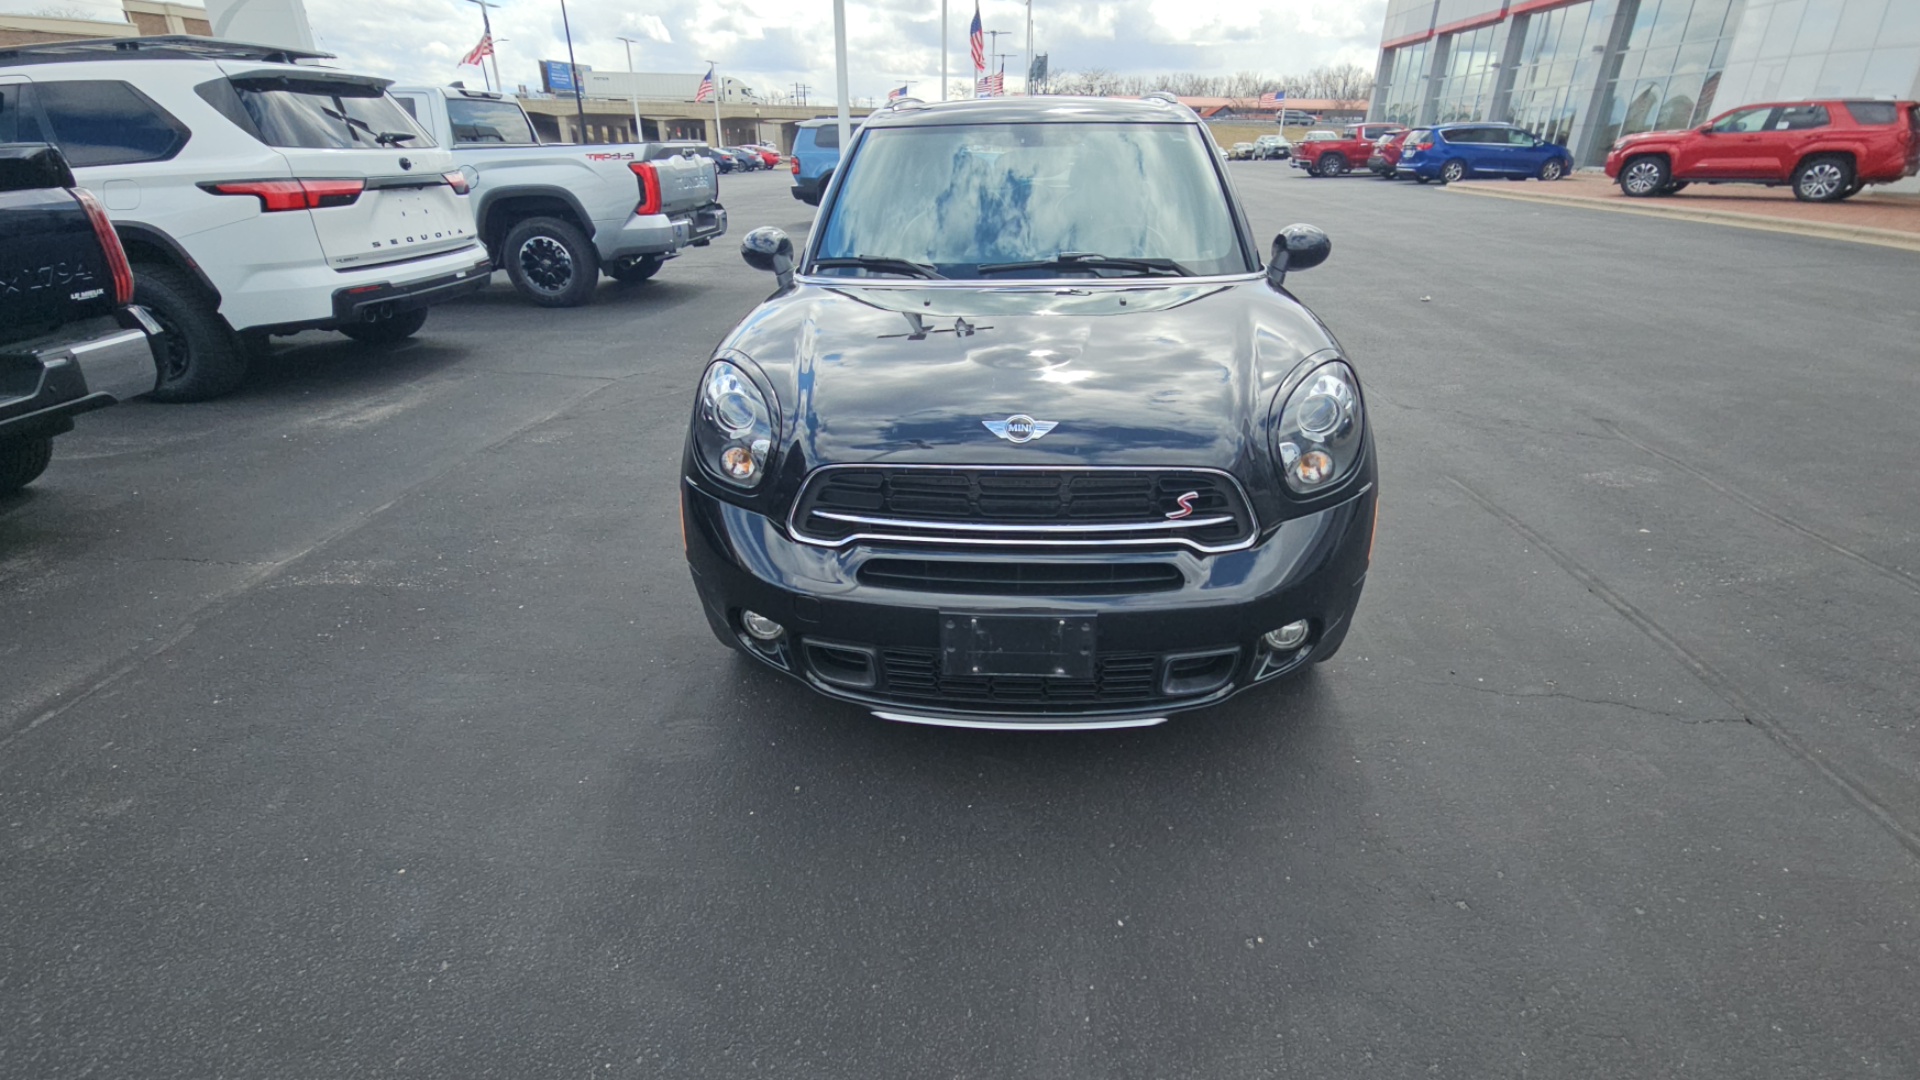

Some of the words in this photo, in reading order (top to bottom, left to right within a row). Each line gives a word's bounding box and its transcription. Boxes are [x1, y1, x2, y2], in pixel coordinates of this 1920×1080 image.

[371, 228, 463, 248] SEQUOIA
[1008, 423, 1032, 432] MINI
[1165, 491, 1199, 519] S
